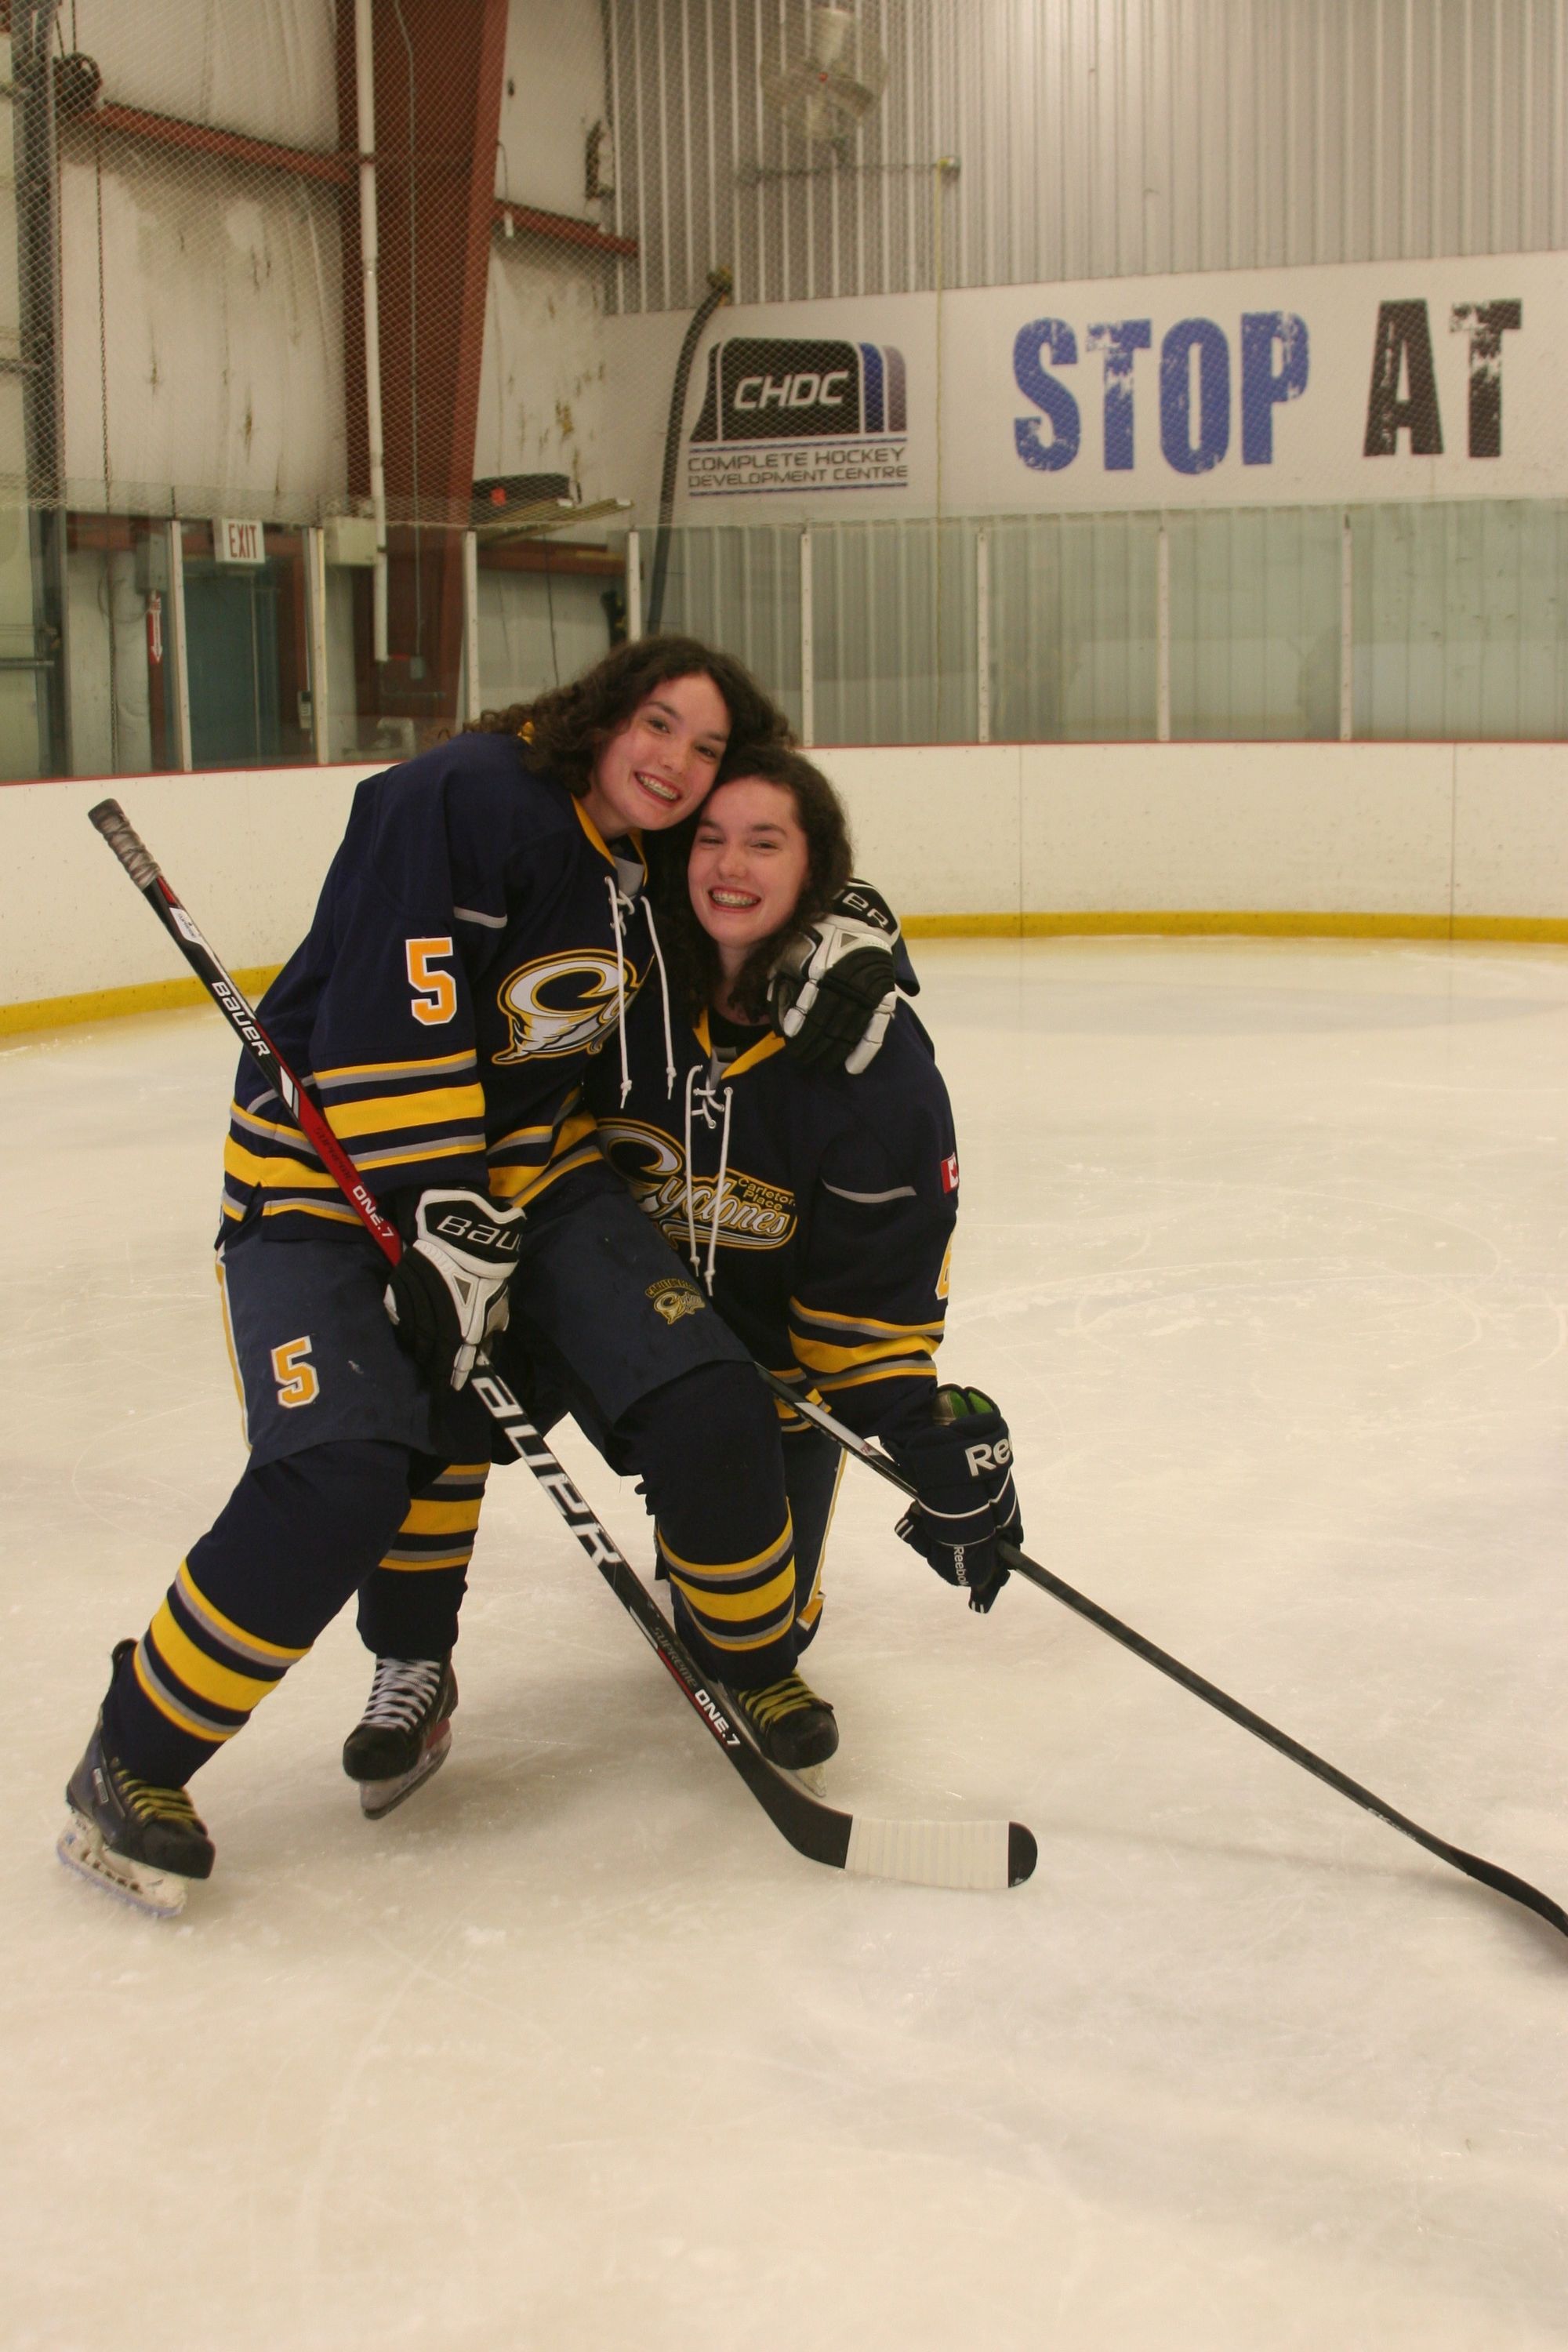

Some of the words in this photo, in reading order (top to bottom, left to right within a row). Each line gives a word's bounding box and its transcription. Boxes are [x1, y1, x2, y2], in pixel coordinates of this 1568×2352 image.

[734, 370, 850, 409] CHDC
[1013, 311, 1310, 475] STOP
[1363, 298, 1523, 458] AT
[688, 452, 808, 471] COMPLETE
[815, 446, 906, 466] HOCKEY
[688, 469, 827, 488] DEVELOPMENT
[833, 465, 909, 481] CENTRE
[228, 523, 257, 559] EXIT
[405, 936, 457, 1026] 5
[742, 1189, 783, 1211] Place
[271, 1335, 320, 1409] 5
[965, 1438, 1012, 1477] Re
[695, 1689, 741, 1746] ONE.7
